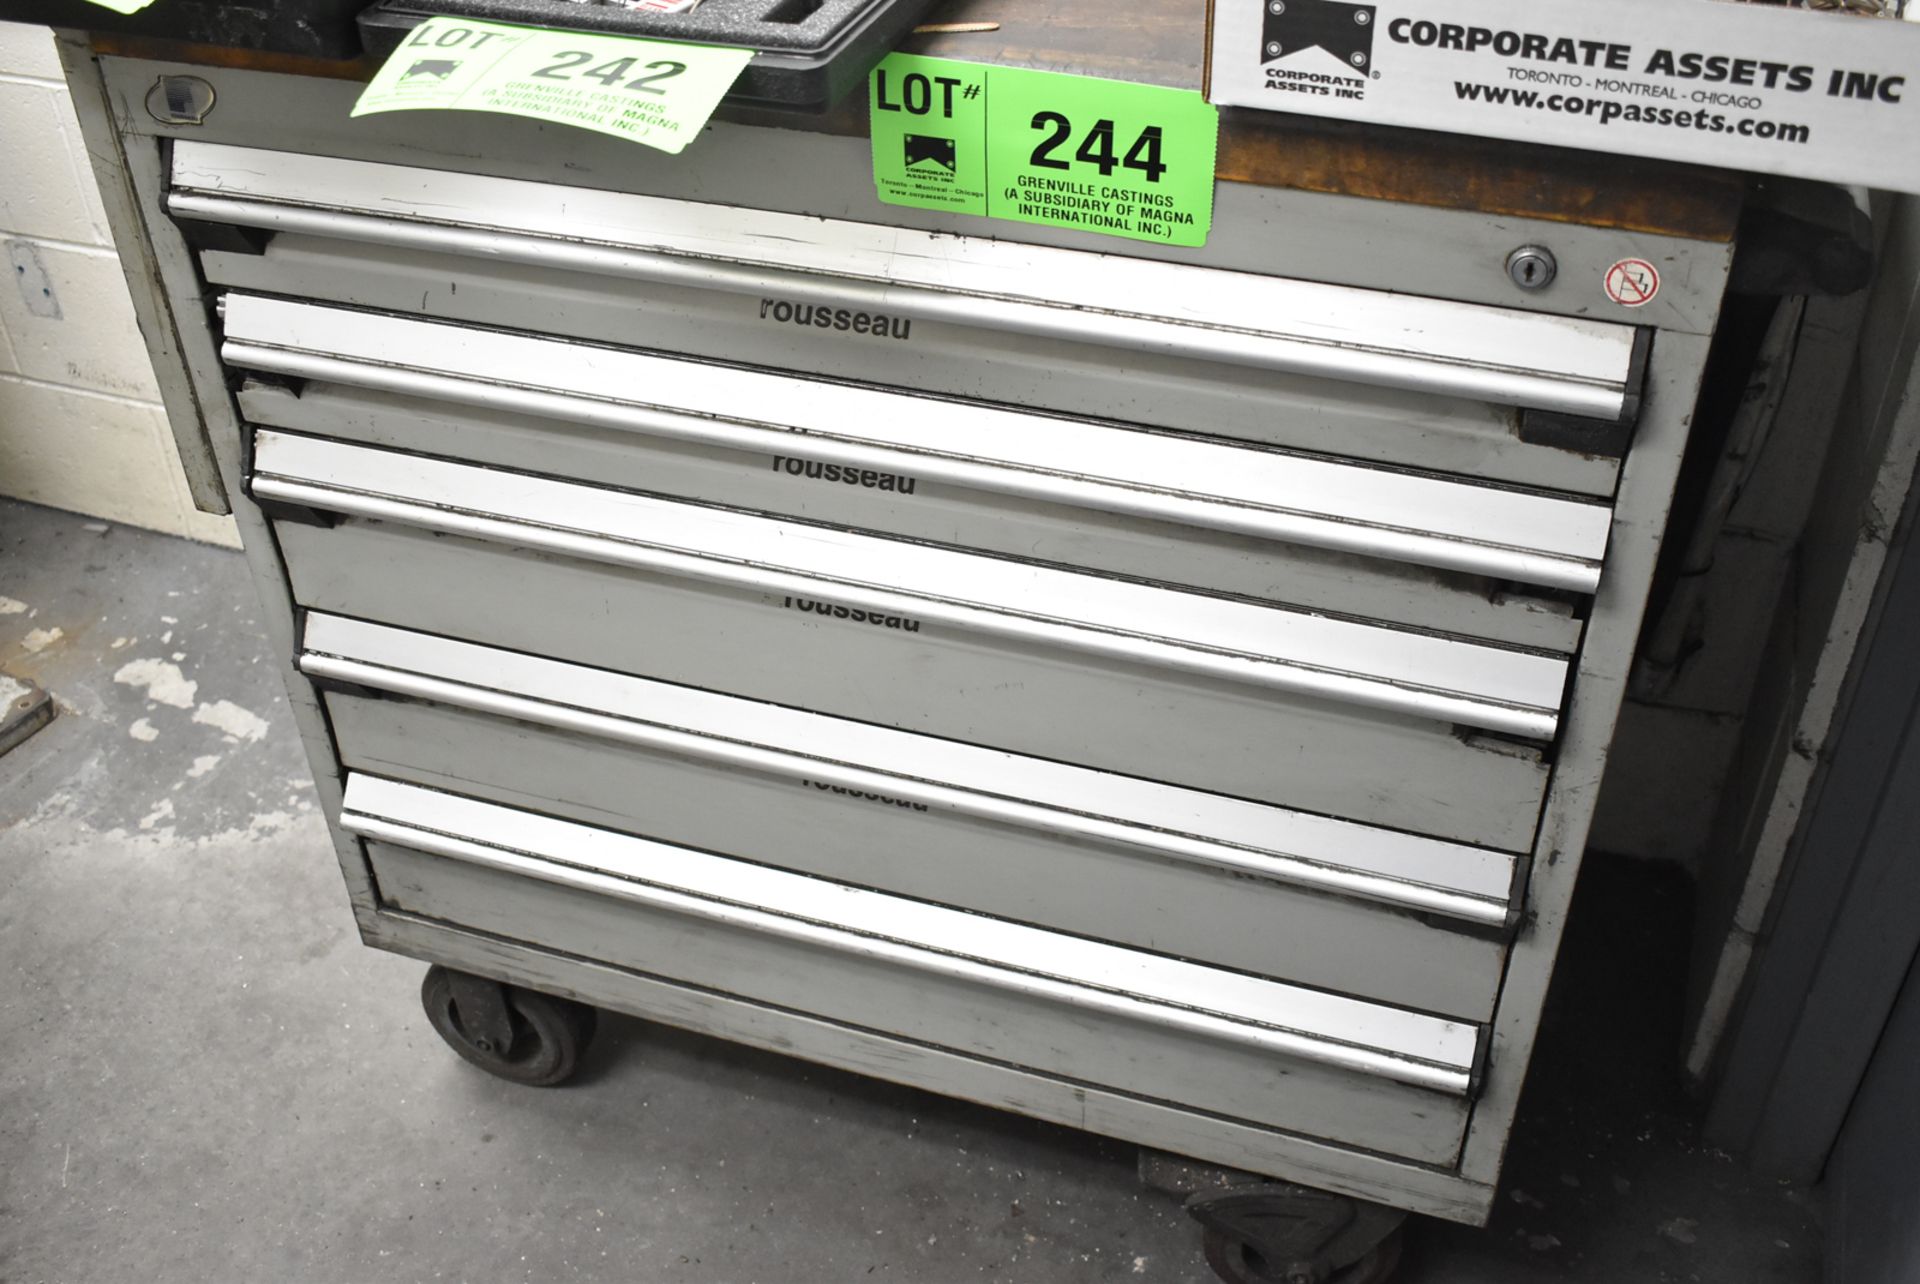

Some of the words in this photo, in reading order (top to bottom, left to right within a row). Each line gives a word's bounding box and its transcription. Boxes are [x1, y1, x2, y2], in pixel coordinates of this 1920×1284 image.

[530, 51, 687, 95] 242
[1266, 68, 1365, 88] CORPORATE
[1387, 17, 1631, 71] CORPORATE
[1644, 47, 1814, 93] ASSETS
[1827, 69, 1905, 104] INC
[505, 81, 584, 97] GRENVILLE
[590, 92, 666, 114] CASTINGS
[1265, 80, 1330, 95] ASSETS
[1335, 88, 1364, 100] INC
[1507, 66, 1583, 88] TORONTO
[1595, 78, 1678, 100] MONTREAL
[1690, 90, 1762, 110] CHICAGO
[488, 98, 604, 124] INTERNATIONAL
[503, 90, 591, 108] SUBSIDIARY
[596, 103, 617, 113] OF
[622, 109, 680, 132] MAGNA
[1454, 81, 1810, 144] www.corpassets.com
[1029, 110, 1167, 183] 244
[881, 178, 908, 188] Toronto
[915, 183, 947, 193] Montreal
[955, 188, 984, 198] Chicago
[905, 167, 955, 178] CORPORATE
[906, 173, 938, 182] ASSETS
[889, 189, 966, 203] www.corpassets.com
[1004, 187, 1018, 200] (A
[1024, 190, 1110, 212] SUBSIDIARY
[1116, 203, 1134, 216] OF
[1140, 207, 1194, 225] MAGNA
[1018, 175, 1095, 196] GRENVILLE
[1101, 186, 1174, 208] CASTINGS
[1018, 203, 1132, 231] INTERNATIONAL
[1137, 221, 1172, 238] INC.)
[760, 298, 911, 340] rousseau
[772, 455, 916, 495] rousseau
